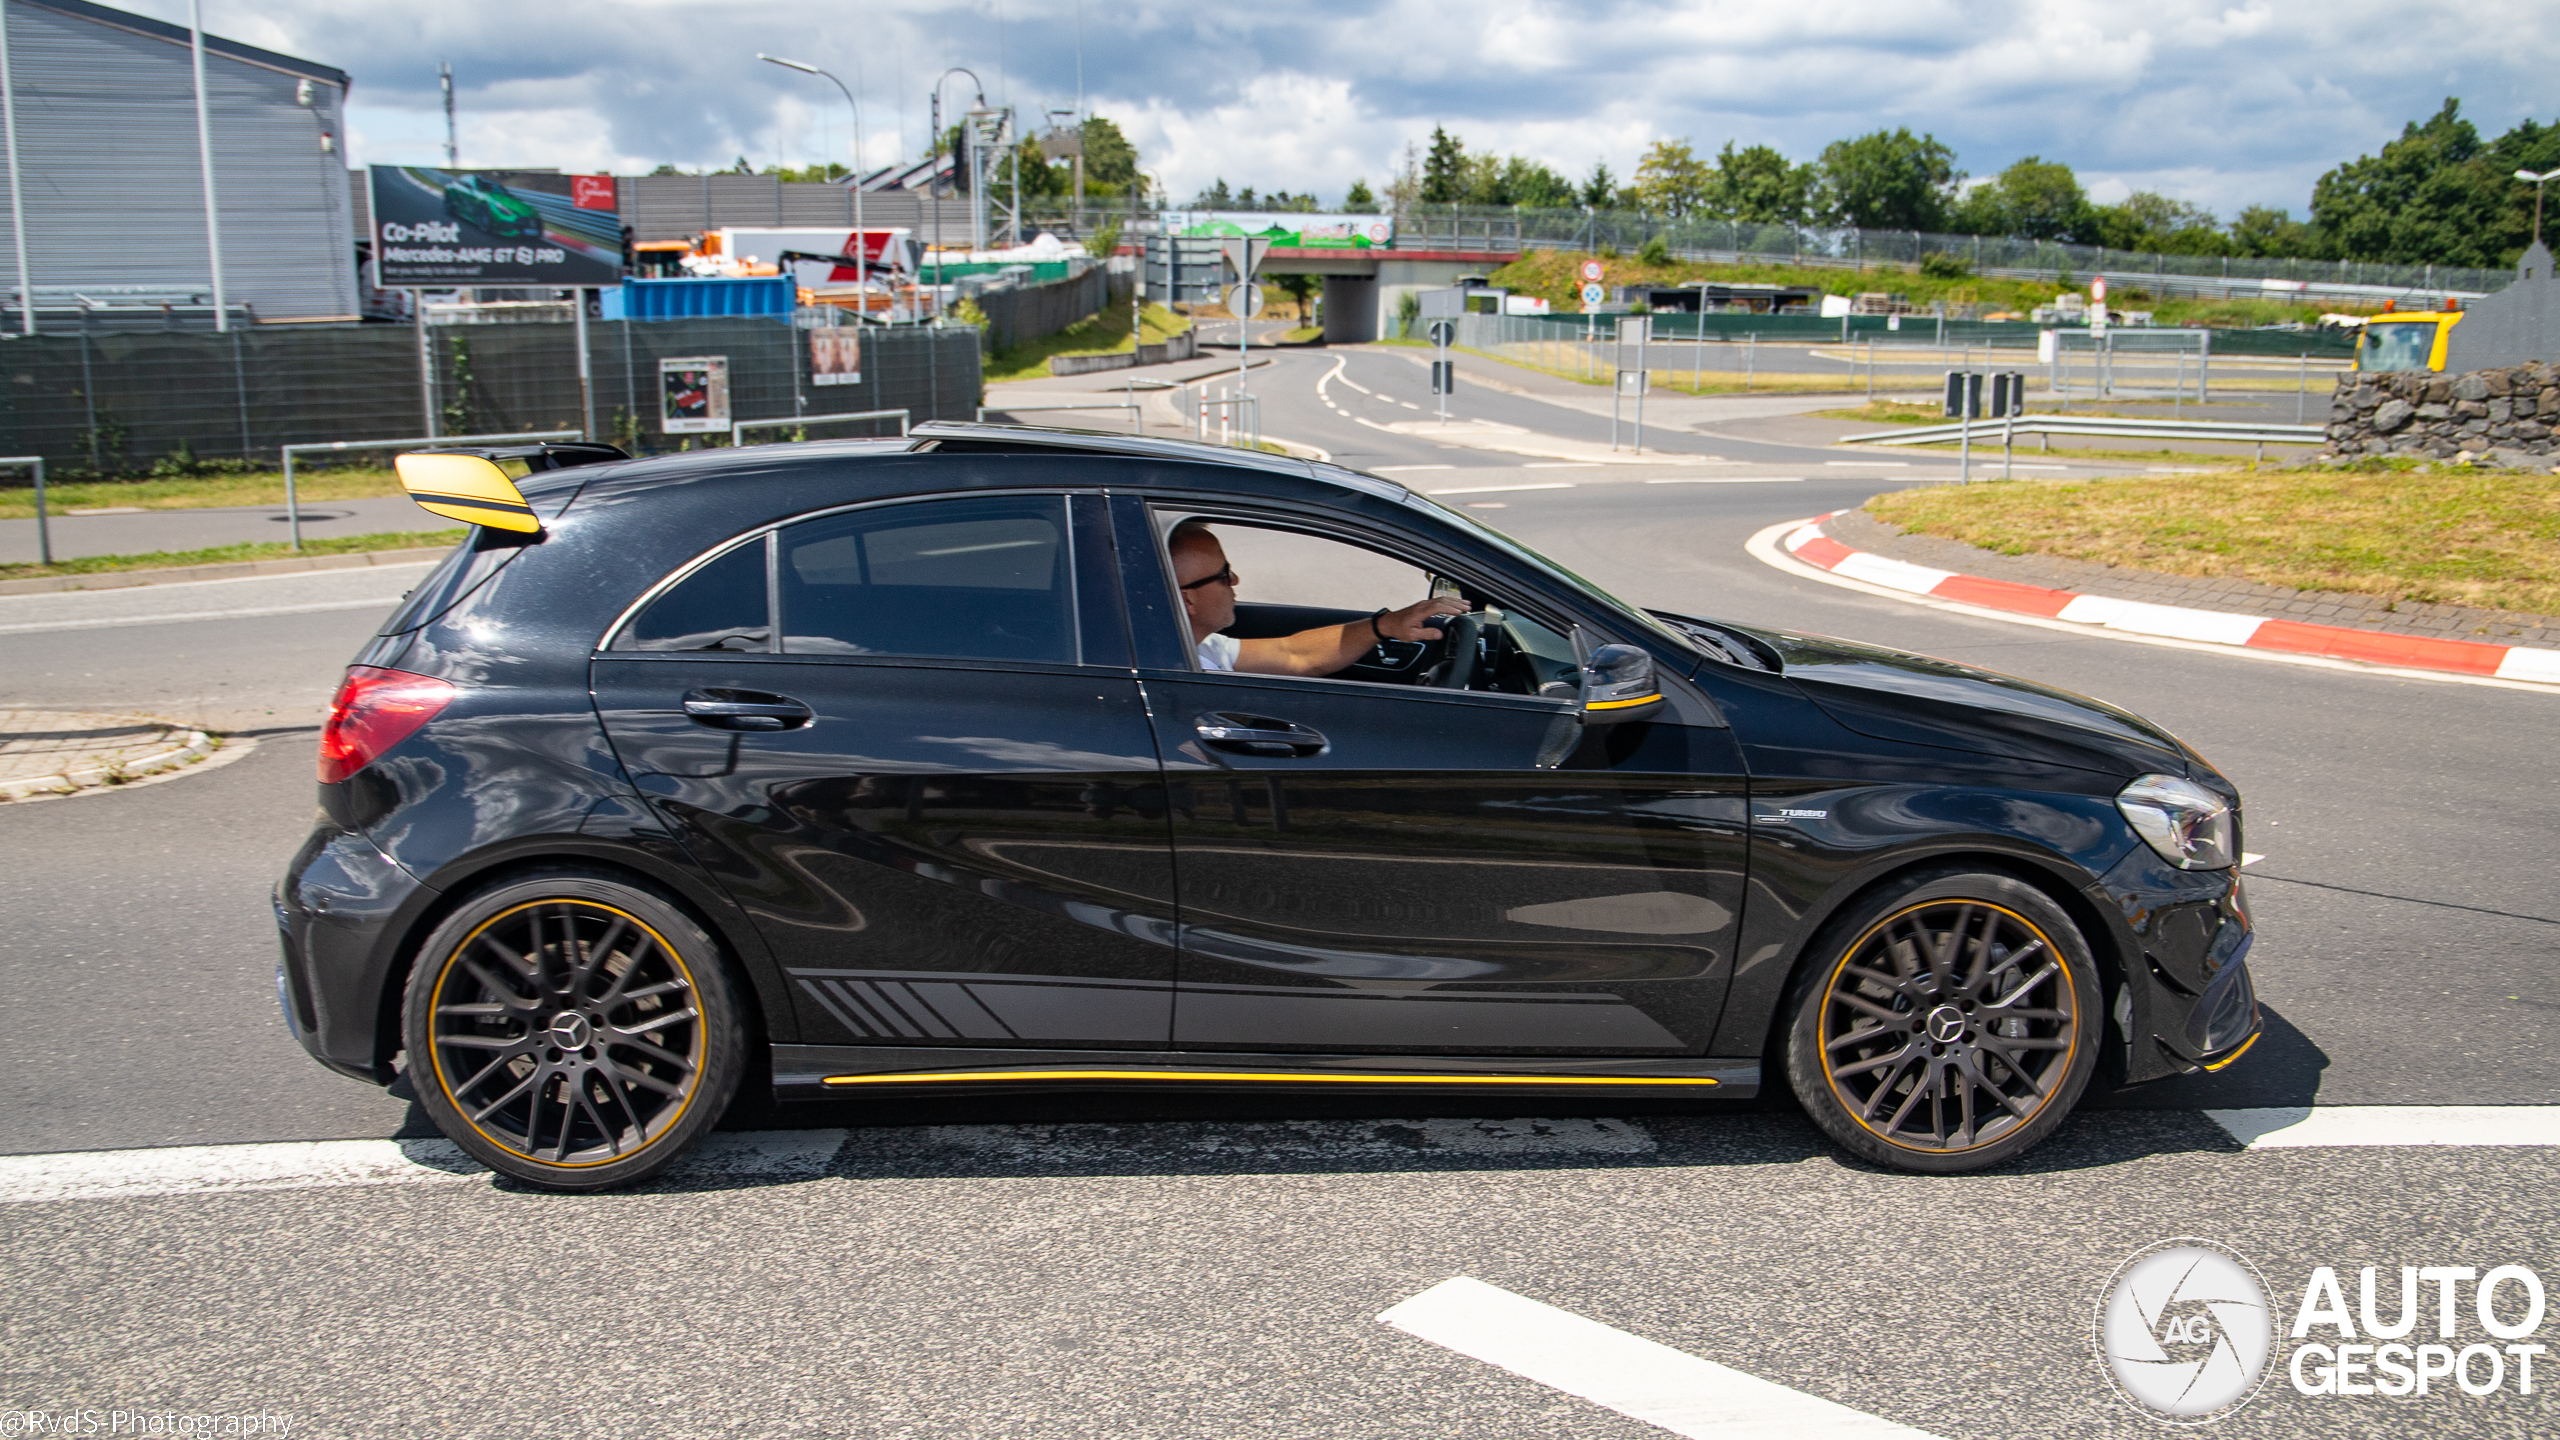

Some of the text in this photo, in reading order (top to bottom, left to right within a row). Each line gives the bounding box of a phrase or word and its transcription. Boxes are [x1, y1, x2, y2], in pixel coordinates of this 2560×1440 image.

[382, 221, 461, 243] Co-Pilot
[383, 245, 493, 263] Mercedes-AMG
[494, 247, 516, 263] GT
[535, 247, 566, 264] PRO
[1779, 809, 1827, 817] TURBO
